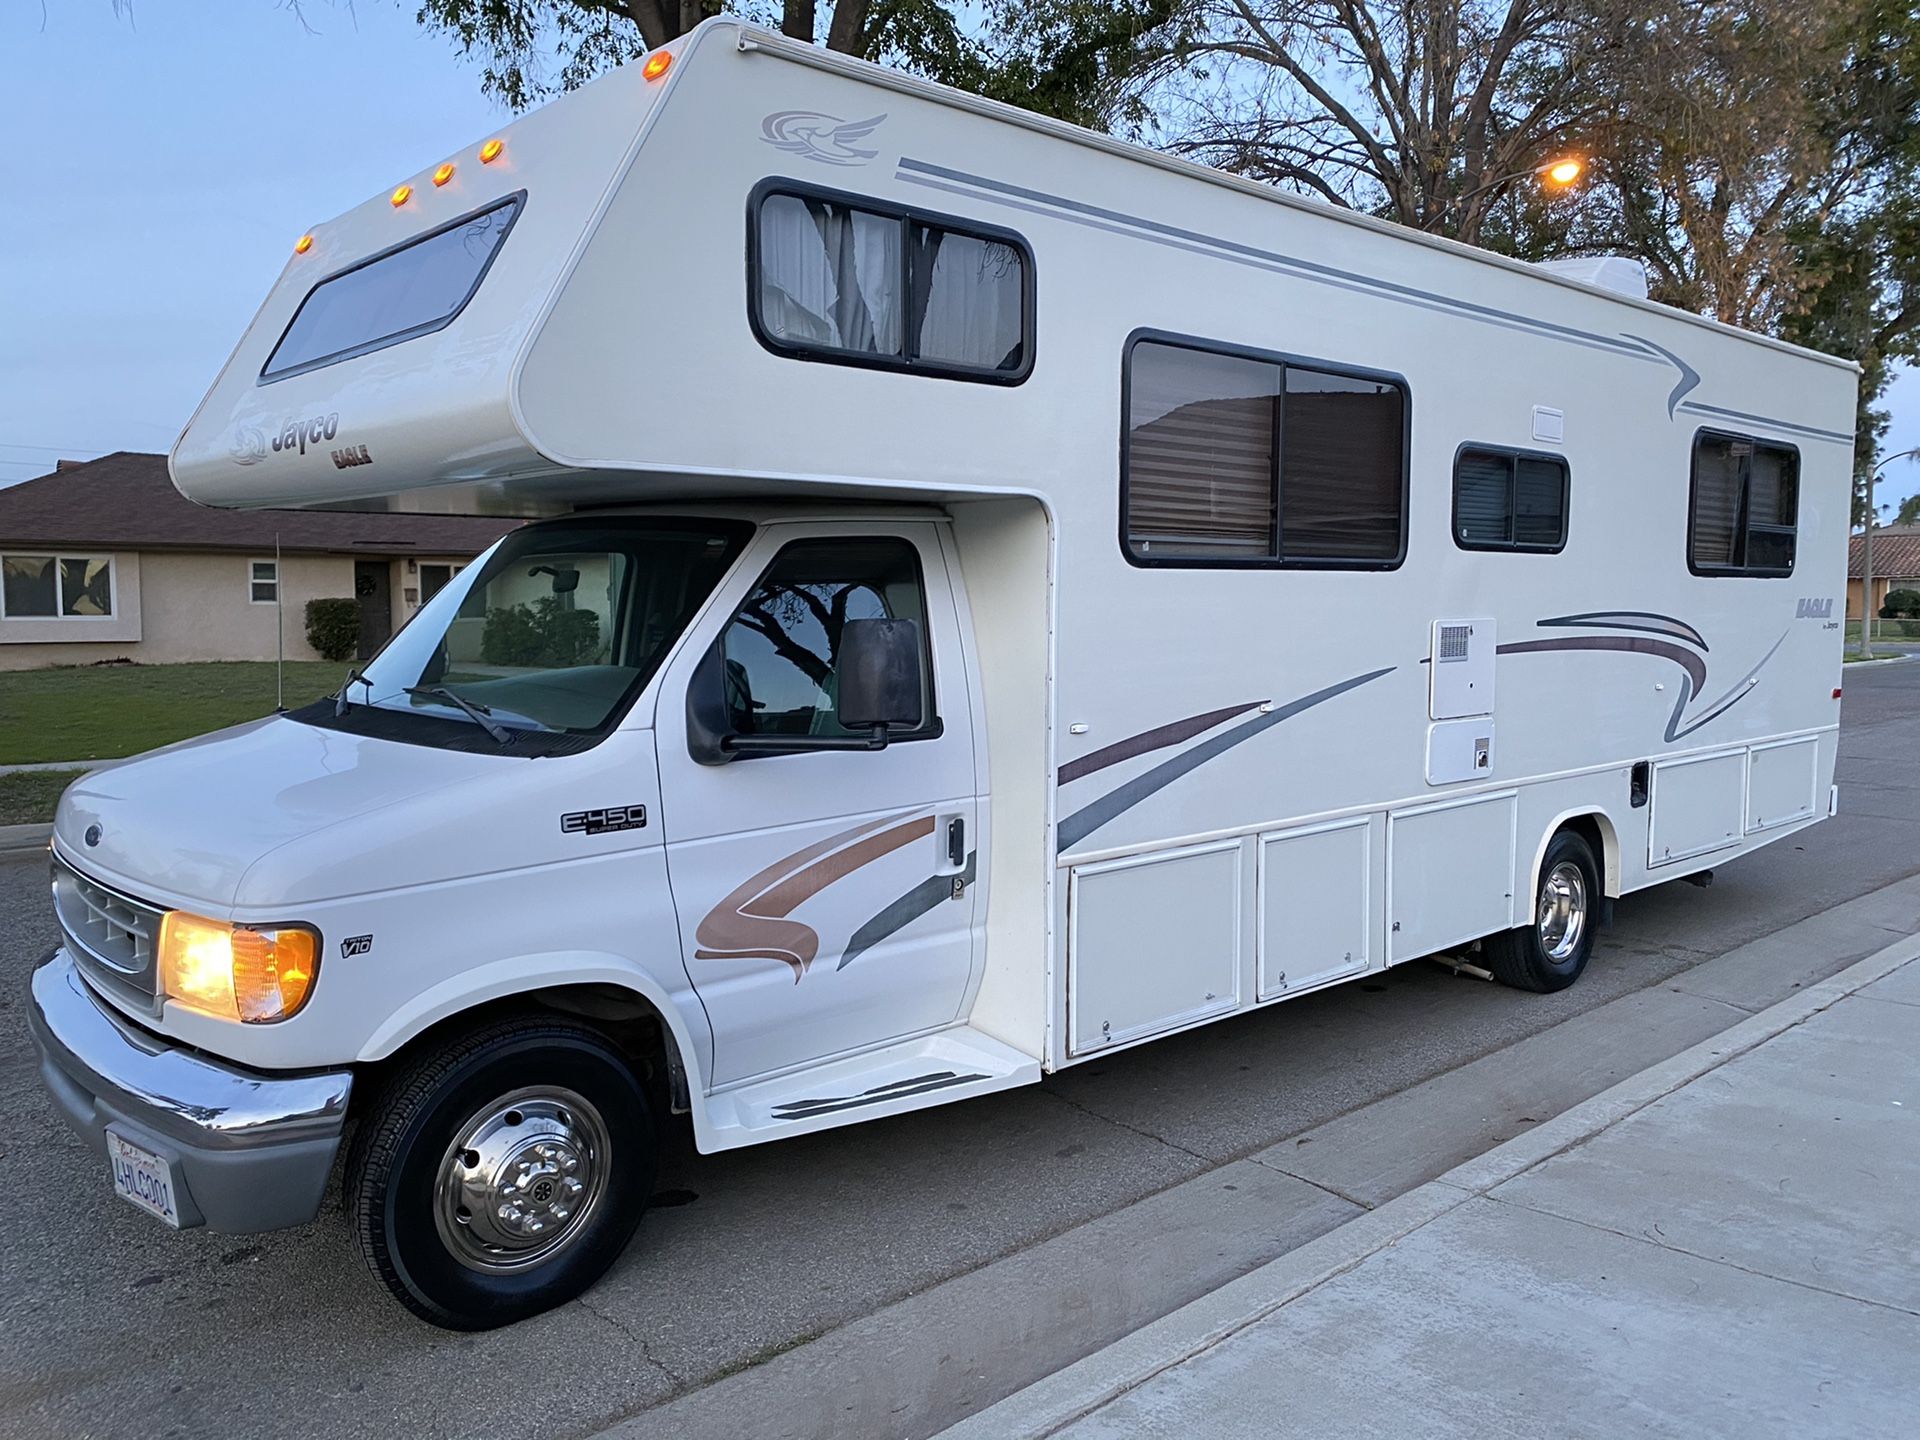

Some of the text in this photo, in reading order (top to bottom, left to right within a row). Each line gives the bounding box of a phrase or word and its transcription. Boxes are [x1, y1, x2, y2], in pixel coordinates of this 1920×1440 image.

[272, 412, 339, 455] Jayco
[331, 444, 374, 469] EAGLE
[1796, 598, 1833, 619] EAGLE
[589, 822, 644, 834] SUPER DUTY
[342, 941, 370, 957] V10
